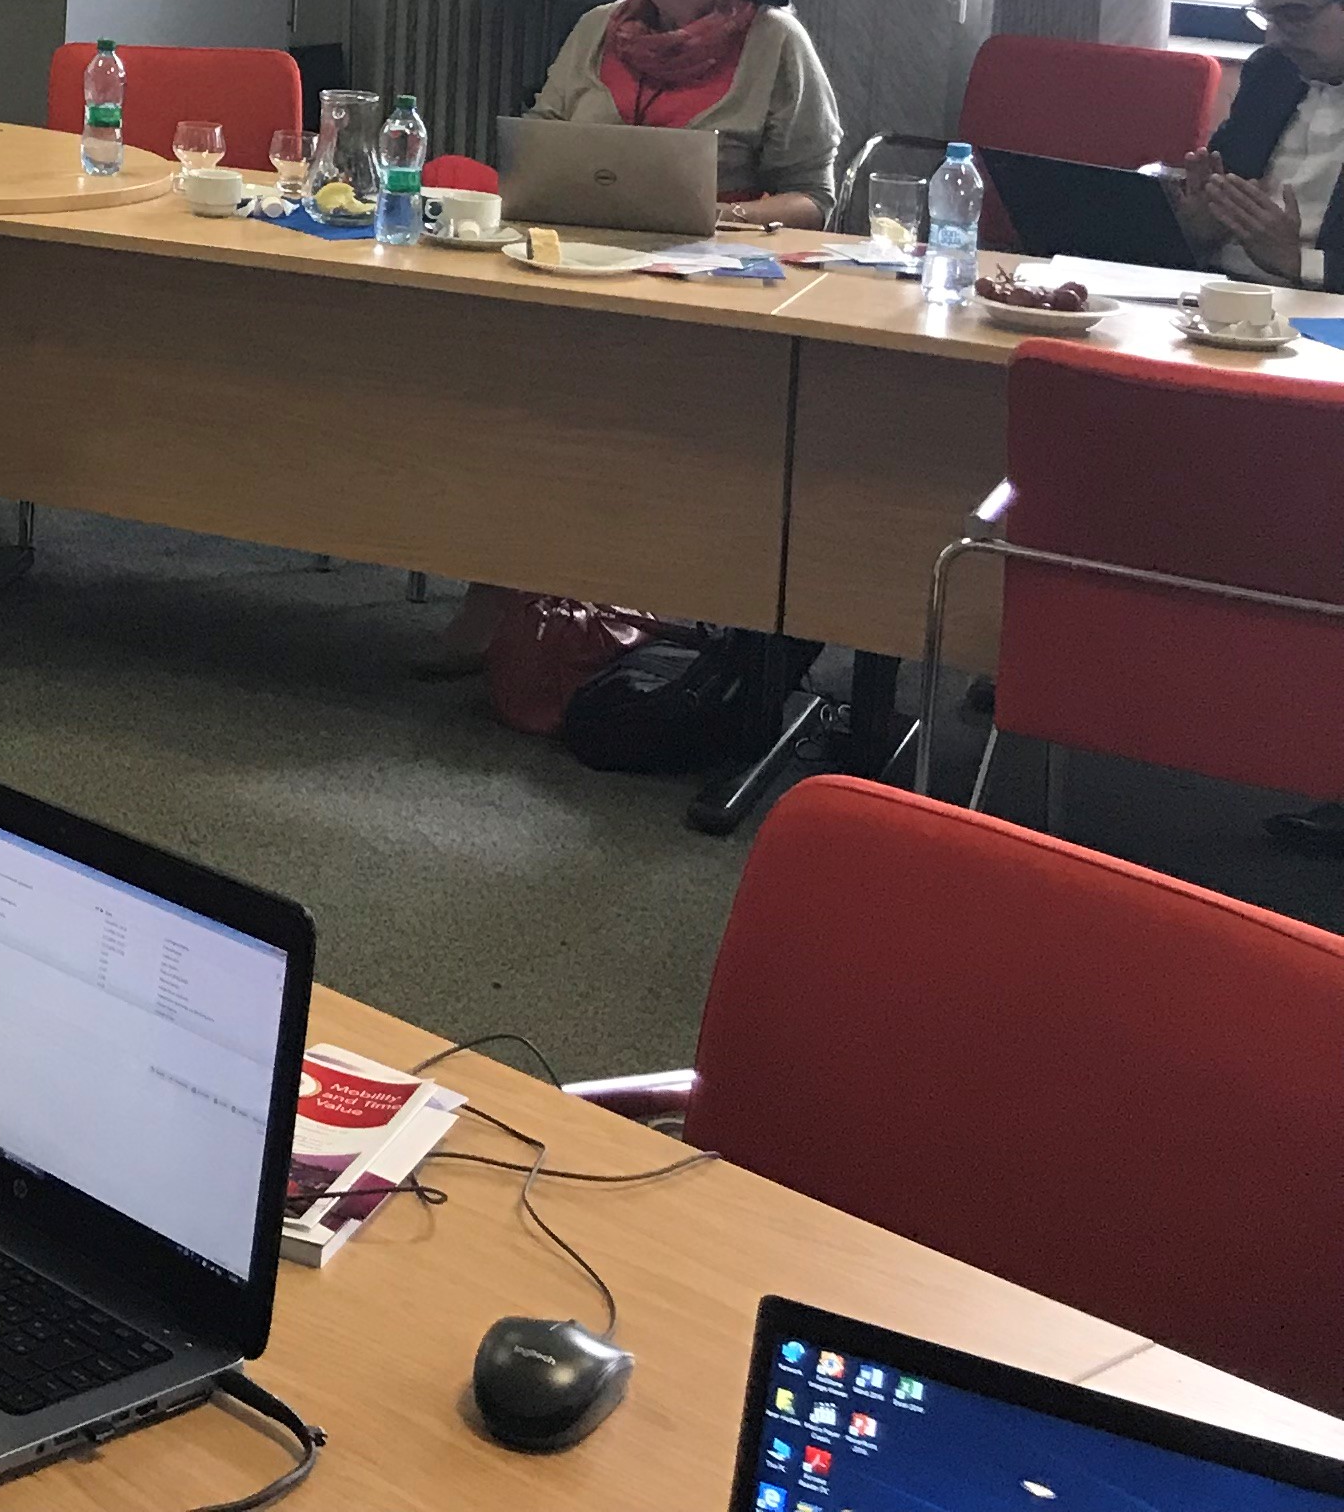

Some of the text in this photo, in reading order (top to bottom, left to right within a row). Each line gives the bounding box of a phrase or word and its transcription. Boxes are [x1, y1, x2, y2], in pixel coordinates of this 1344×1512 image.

[322, 1092, 358, 1105] and
[330, 1083, 402, 1103] Mobility
[316, 1098, 363, 1116] Value
